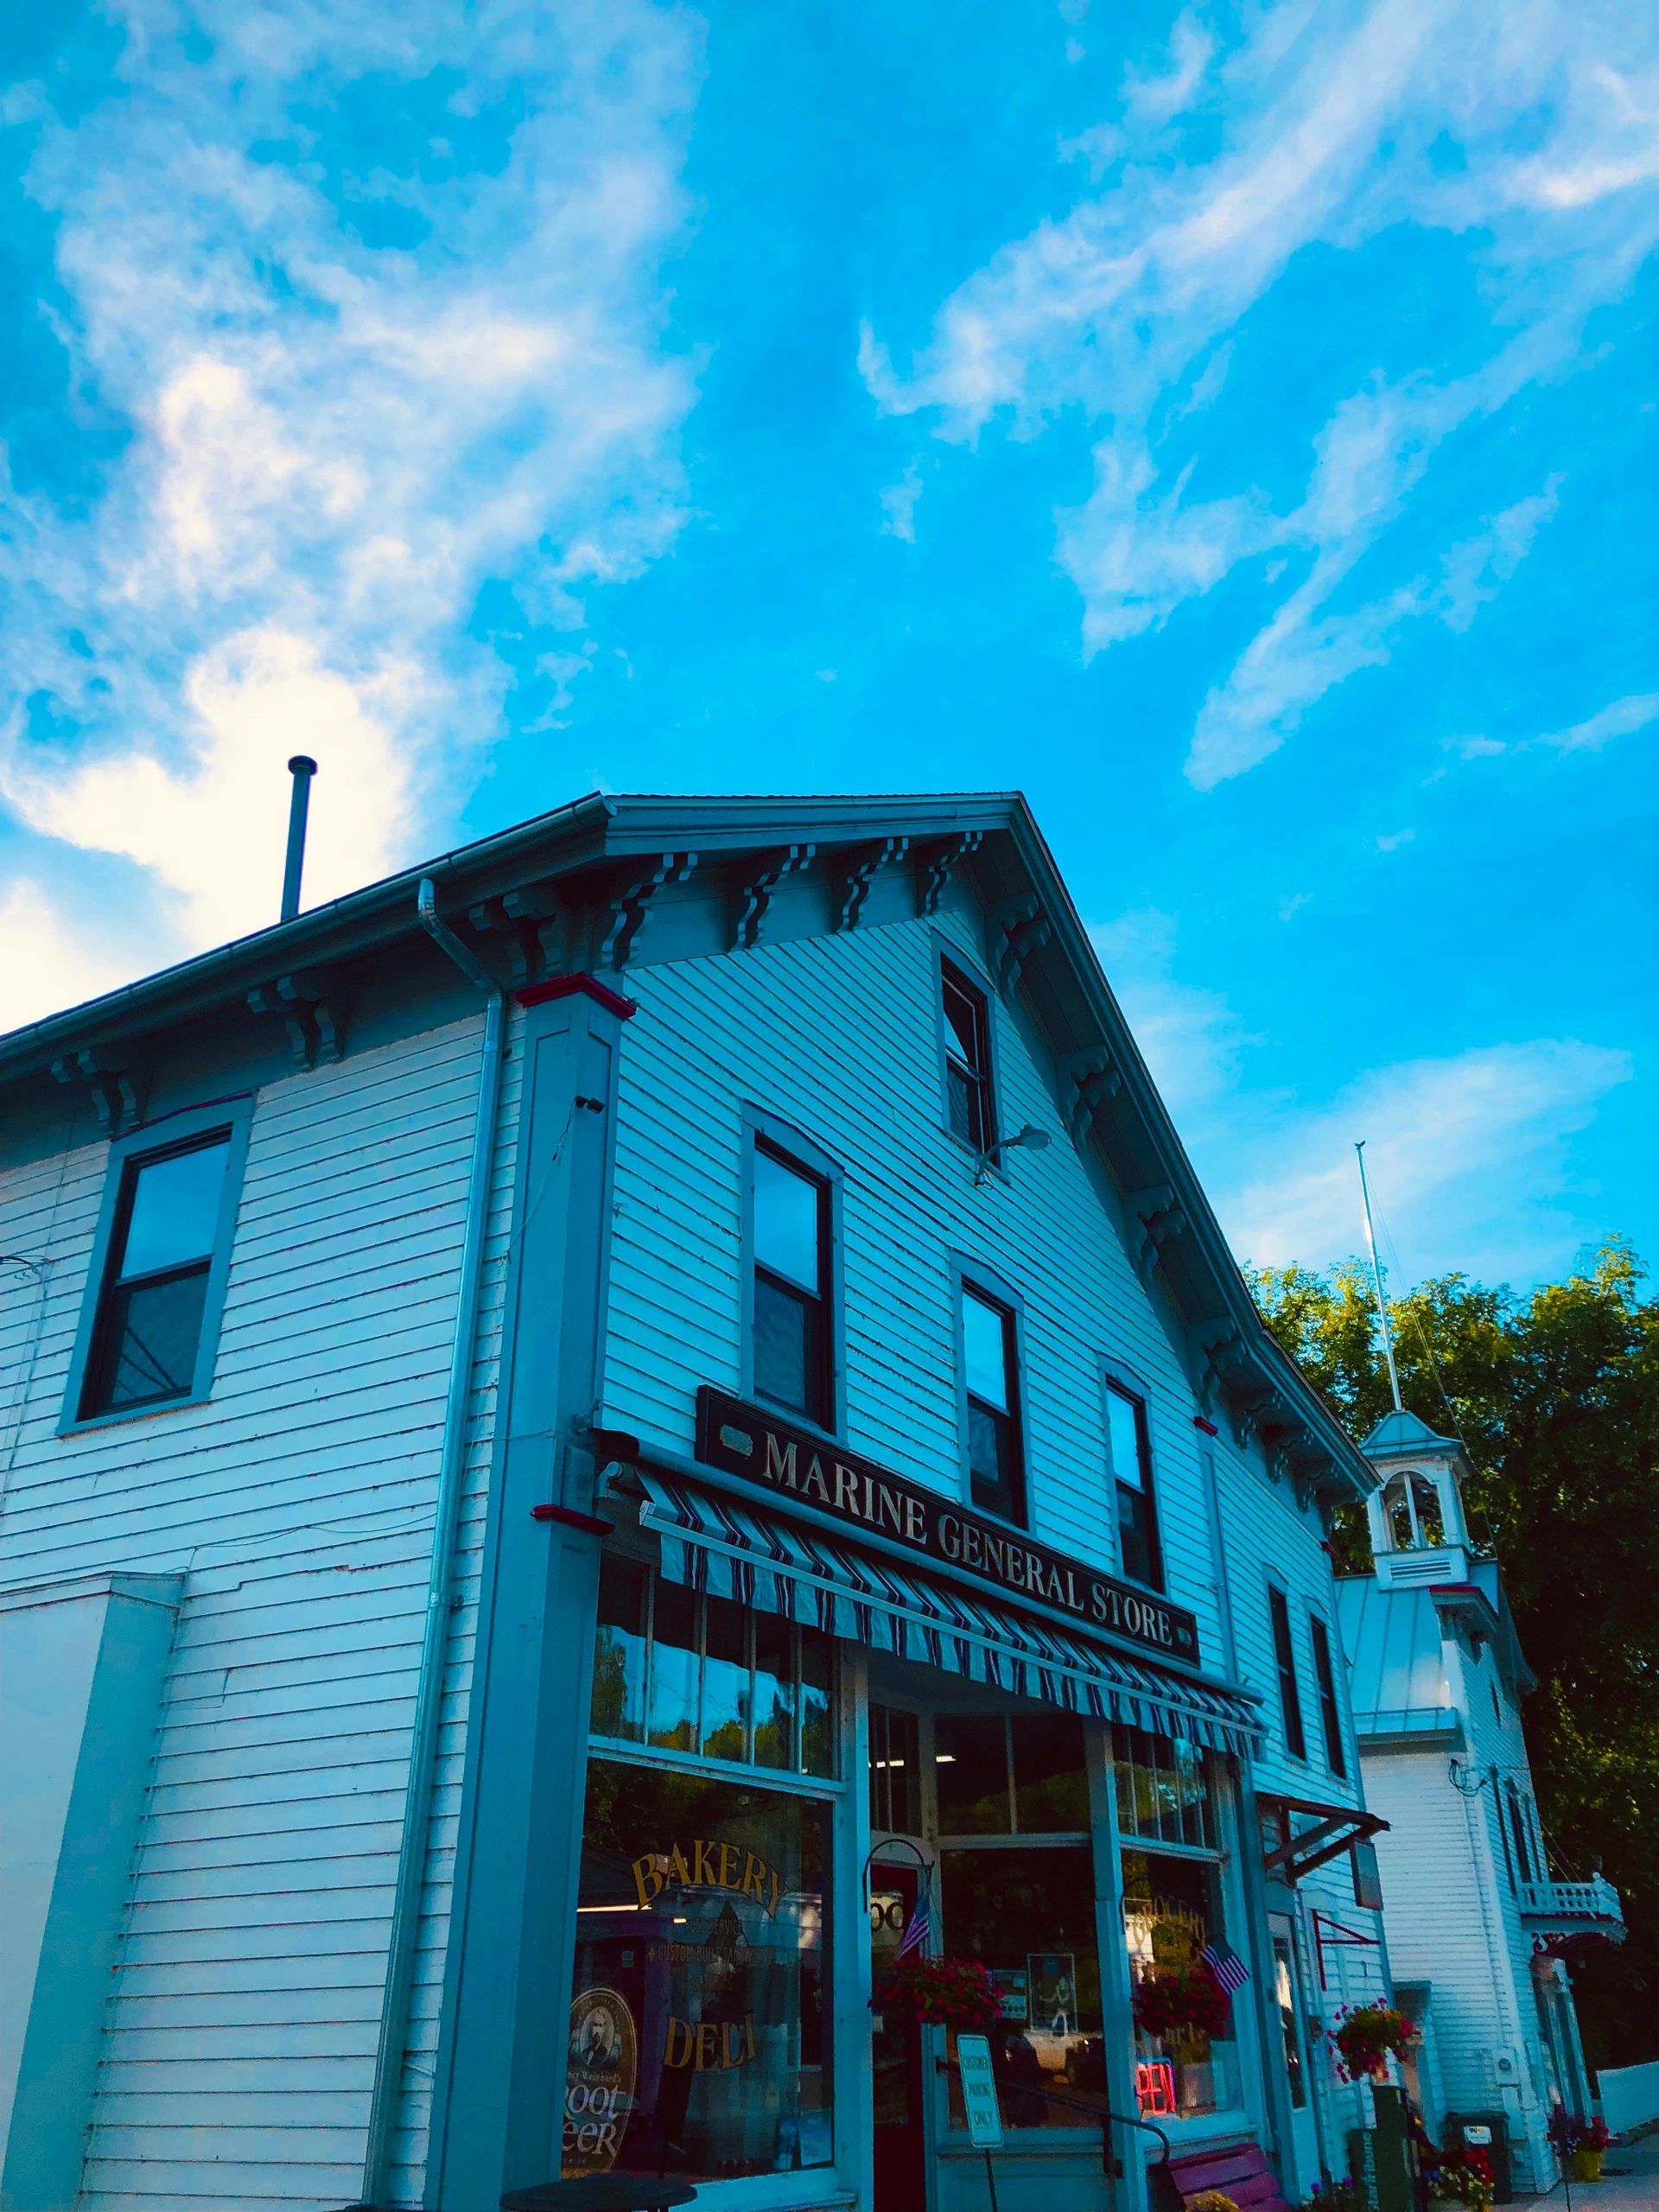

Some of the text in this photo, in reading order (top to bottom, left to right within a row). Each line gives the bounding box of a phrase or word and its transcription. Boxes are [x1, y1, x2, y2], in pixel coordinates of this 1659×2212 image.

[762, 1431, 1173, 1646] MARINE GENERAL STORE
[631, 1839, 790, 1918] BAKERY
[658, 1943, 693, 1963] CUSTOM
[662, 2009, 756, 2072] DELI
[974, 2110, 994, 2126] ONLY
[1135, 2063, 1176, 2116] PEN
